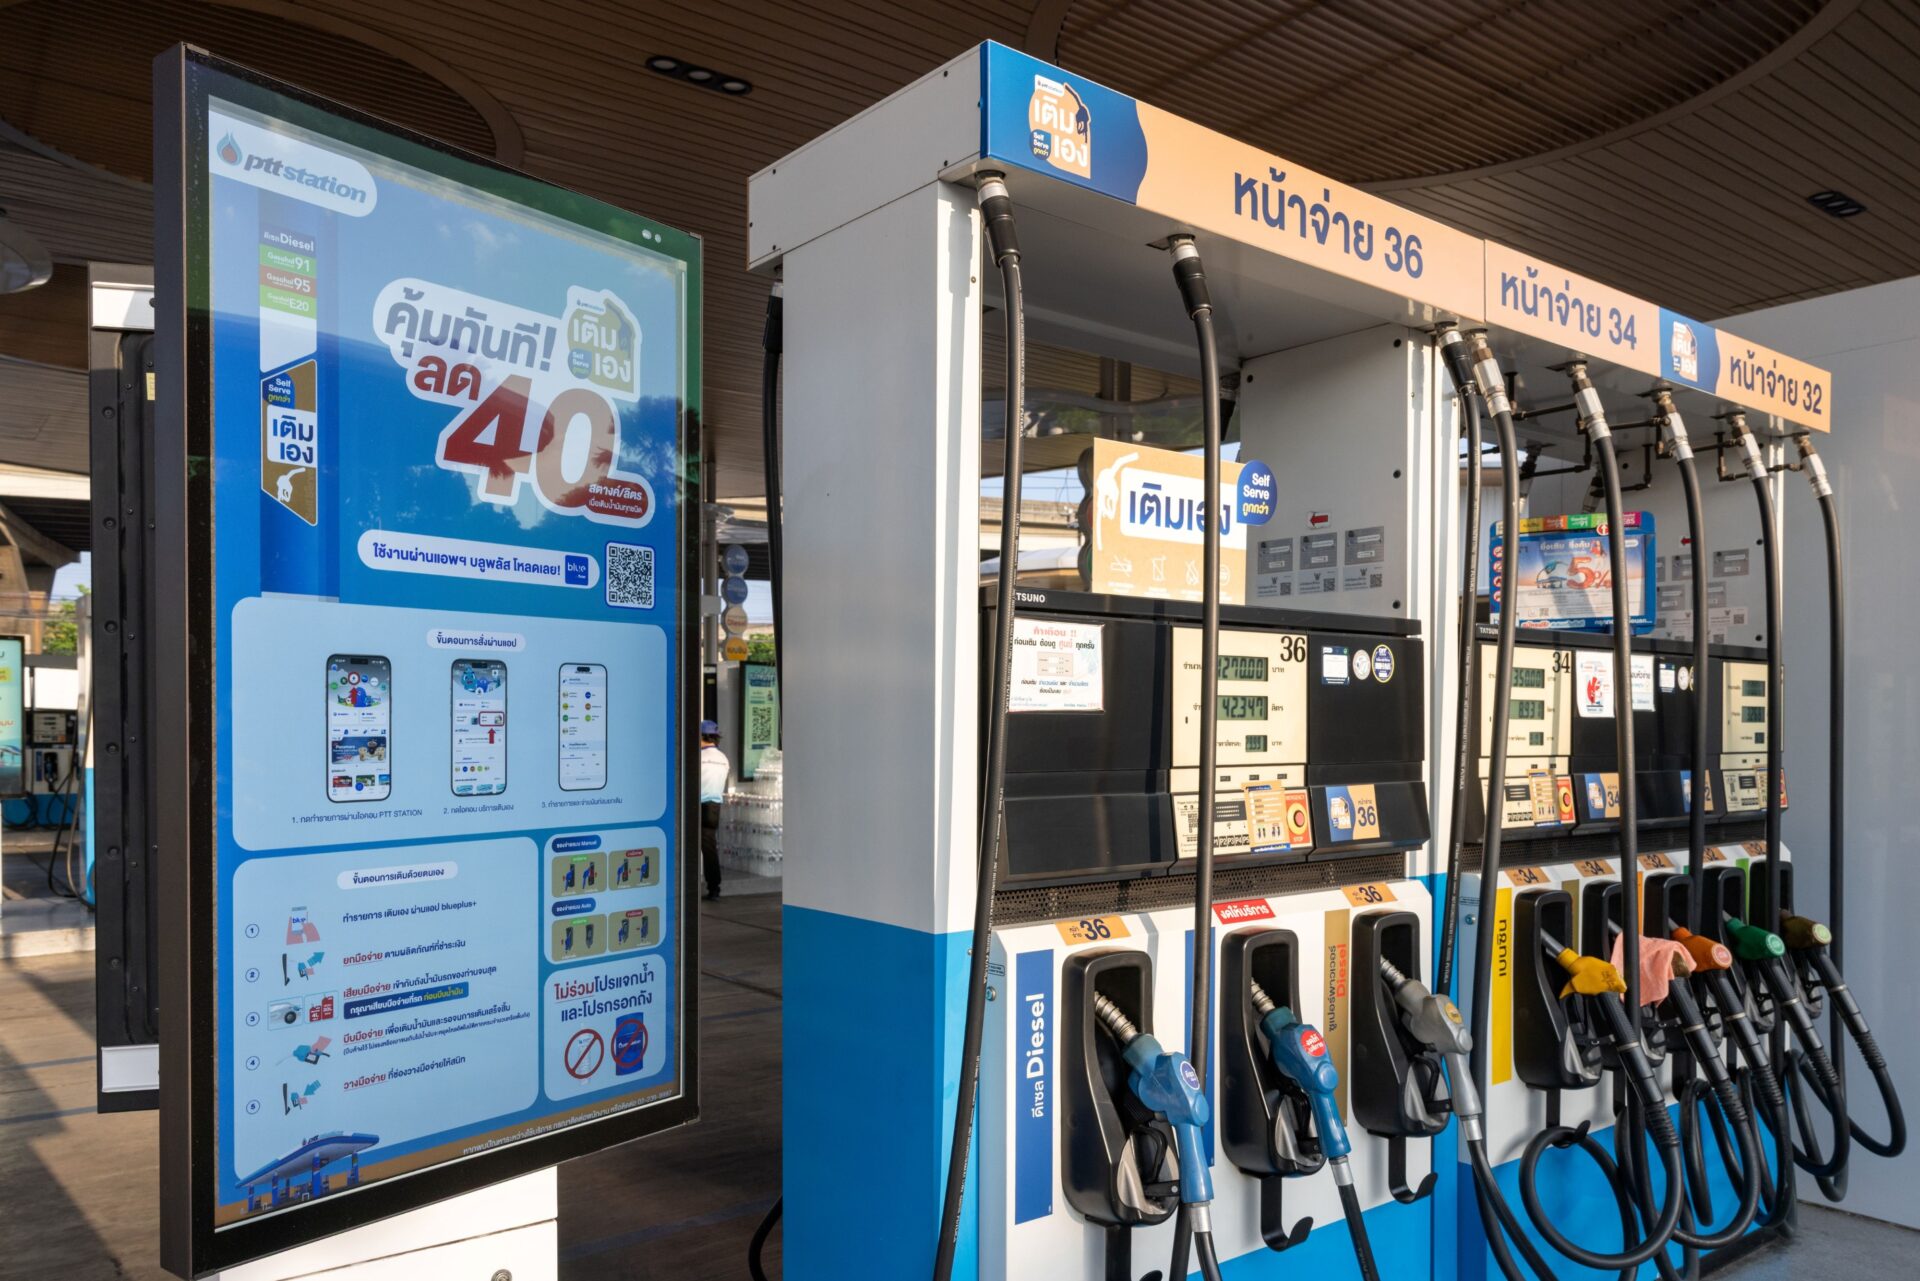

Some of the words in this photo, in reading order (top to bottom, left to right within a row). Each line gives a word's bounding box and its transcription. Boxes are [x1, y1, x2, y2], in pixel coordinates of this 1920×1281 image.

[1034, 95, 1075, 134] เติม
[1054, 134, 1088, 167] เอง
[243, 154, 284, 177] ptt
[282, 164, 367, 204] station
[1234, 167, 1374, 261] หน้าจ่าย
[1384, 226, 1424, 279] 36
[279, 232, 315, 252] Diesel
[267, 251, 295, 264] Gasohol
[294, 256, 310, 272] 91
[266, 272, 294, 285] Gasohol
[294, 277, 311, 293] 95
[289, 298, 310, 312] E20
[1501, 266, 1601, 339] หน้าจ่าย
[1609, 308, 1637, 350] 34
[384, 286, 557, 372] คุ้มทันที!
[572, 313, 617, 351] เติม
[413, 355, 483, 401] ลด
[594, 352, 632, 383] เอง
[268, 384, 291, 395] Serve
[275, 378, 292, 387] Self
[1730, 350, 1798, 407] หน้าจ่าย
[1803, 384, 1823, 415] 32
[272, 415, 314, 443] เติม
[443, 373, 616, 508] 40
[280, 442, 314, 464] เอง
[1252, 472, 1270, 487] Self
[589, 483, 642, 500] สตางค์/ลิตร
[1243, 485, 1270, 500] Serve
[1242, 501, 1269, 516] ถูกกว่า
[373, 542, 467, 567] ใช้งานผ่านแอพฯ
[470, 556, 511, 573] บลูพลัส
[513, 557, 561, 576] โหลดเลย!
[1015, 592, 1046, 603] TSUNO
[436, 631, 517, 648] ขั้นตอนการสั่งผ่านแอป
[1479, 626, 1499, 635] TATSUN
[1280, 635, 1306, 662] 36
[1552, 651, 1571, 674] 34
[379, 811, 393, 819] PTT
[394, 809, 423, 817] STATION
[443, 807, 449, 815] 2.
[1357, 805, 1376, 827] 36
[1585, 860, 1605, 875] 34
[1646, 853, 1665, 868] 32
[353, 868, 445, 884] ขั้นตอนการเติมด้วยตนเอง
[1518, 868, 1539, 884] 34
[1358, 885, 1383, 903] 36
[342, 911, 383, 923] ทำรายการ
[384, 908, 409, 919] เติมเอง
[411, 904, 440, 915] ผ่านแอป
[441, 900, 477, 911] blueplus+
[1221, 902, 1269, 919] งดให้บริการ
[1079, 918, 1110, 940] 36
[343, 951, 383, 965] ยกมือจ่าย
[1498, 918, 1508, 977] เบนซิน
[1337, 943, 1347, 997] Diesel
[554, 963, 654, 1000] ไม่ร่วมโปรแจกน้ำ
[1328, 945, 1338, 1032] ซูเปอร์พาวเวอร์
[561, 990, 653, 1022] และโปรกรอกถัง
[1026, 993, 1045, 1079] Diesel
[1032, 1080, 1044, 1119] ดีเซล
